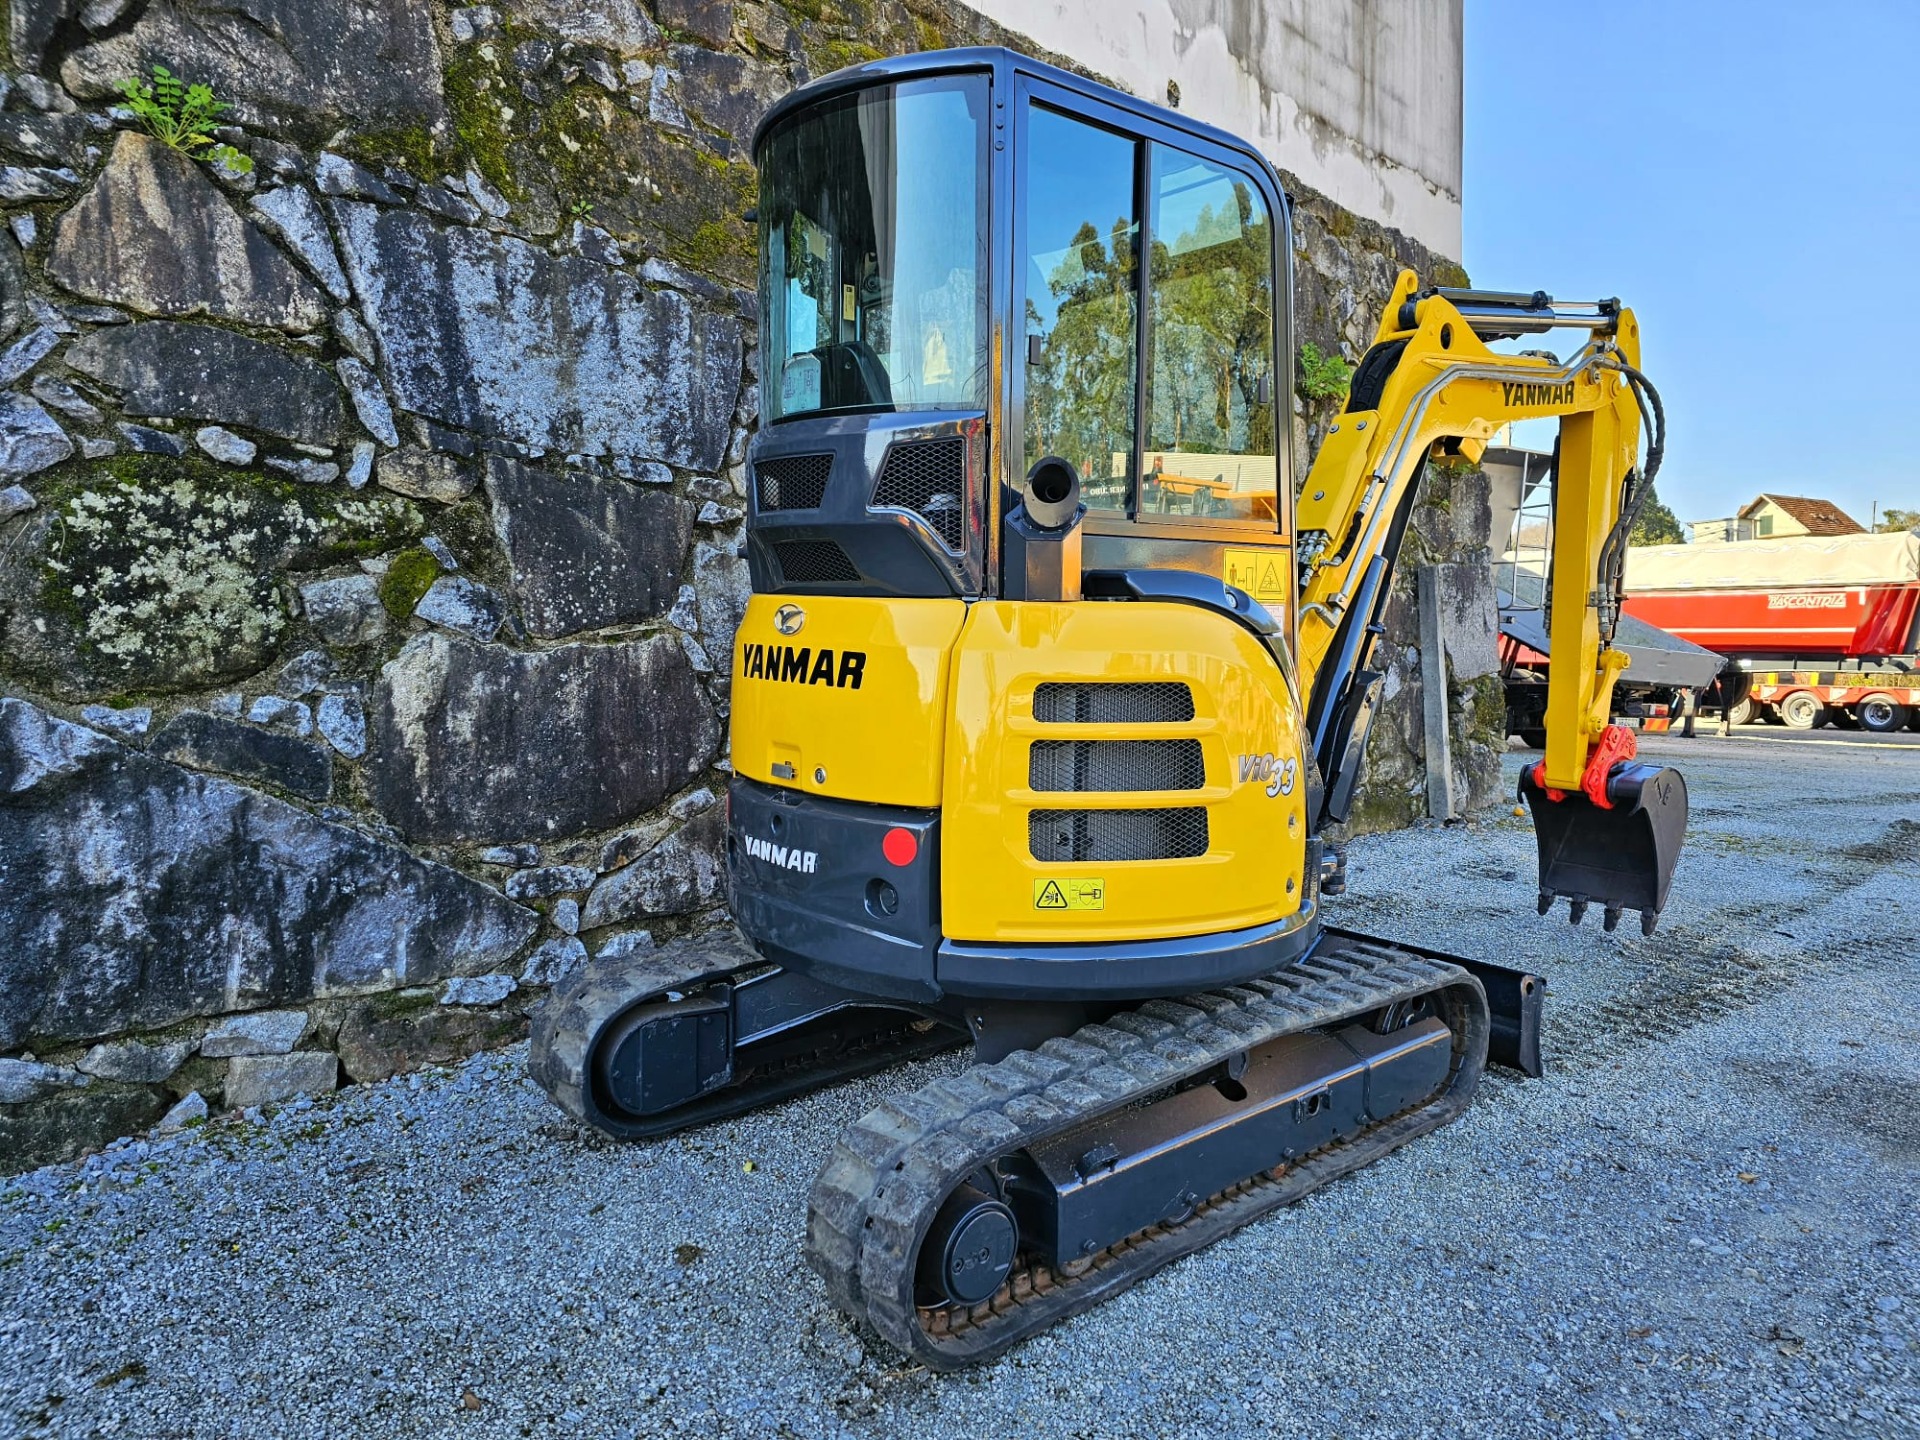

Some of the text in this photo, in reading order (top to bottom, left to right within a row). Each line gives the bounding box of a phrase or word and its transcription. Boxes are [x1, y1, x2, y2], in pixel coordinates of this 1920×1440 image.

[1502, 380, 1575, 407] YANMAR
[743, 643, 867, 690] YANMAR
[745, 835, 817, 874] YANMAR
